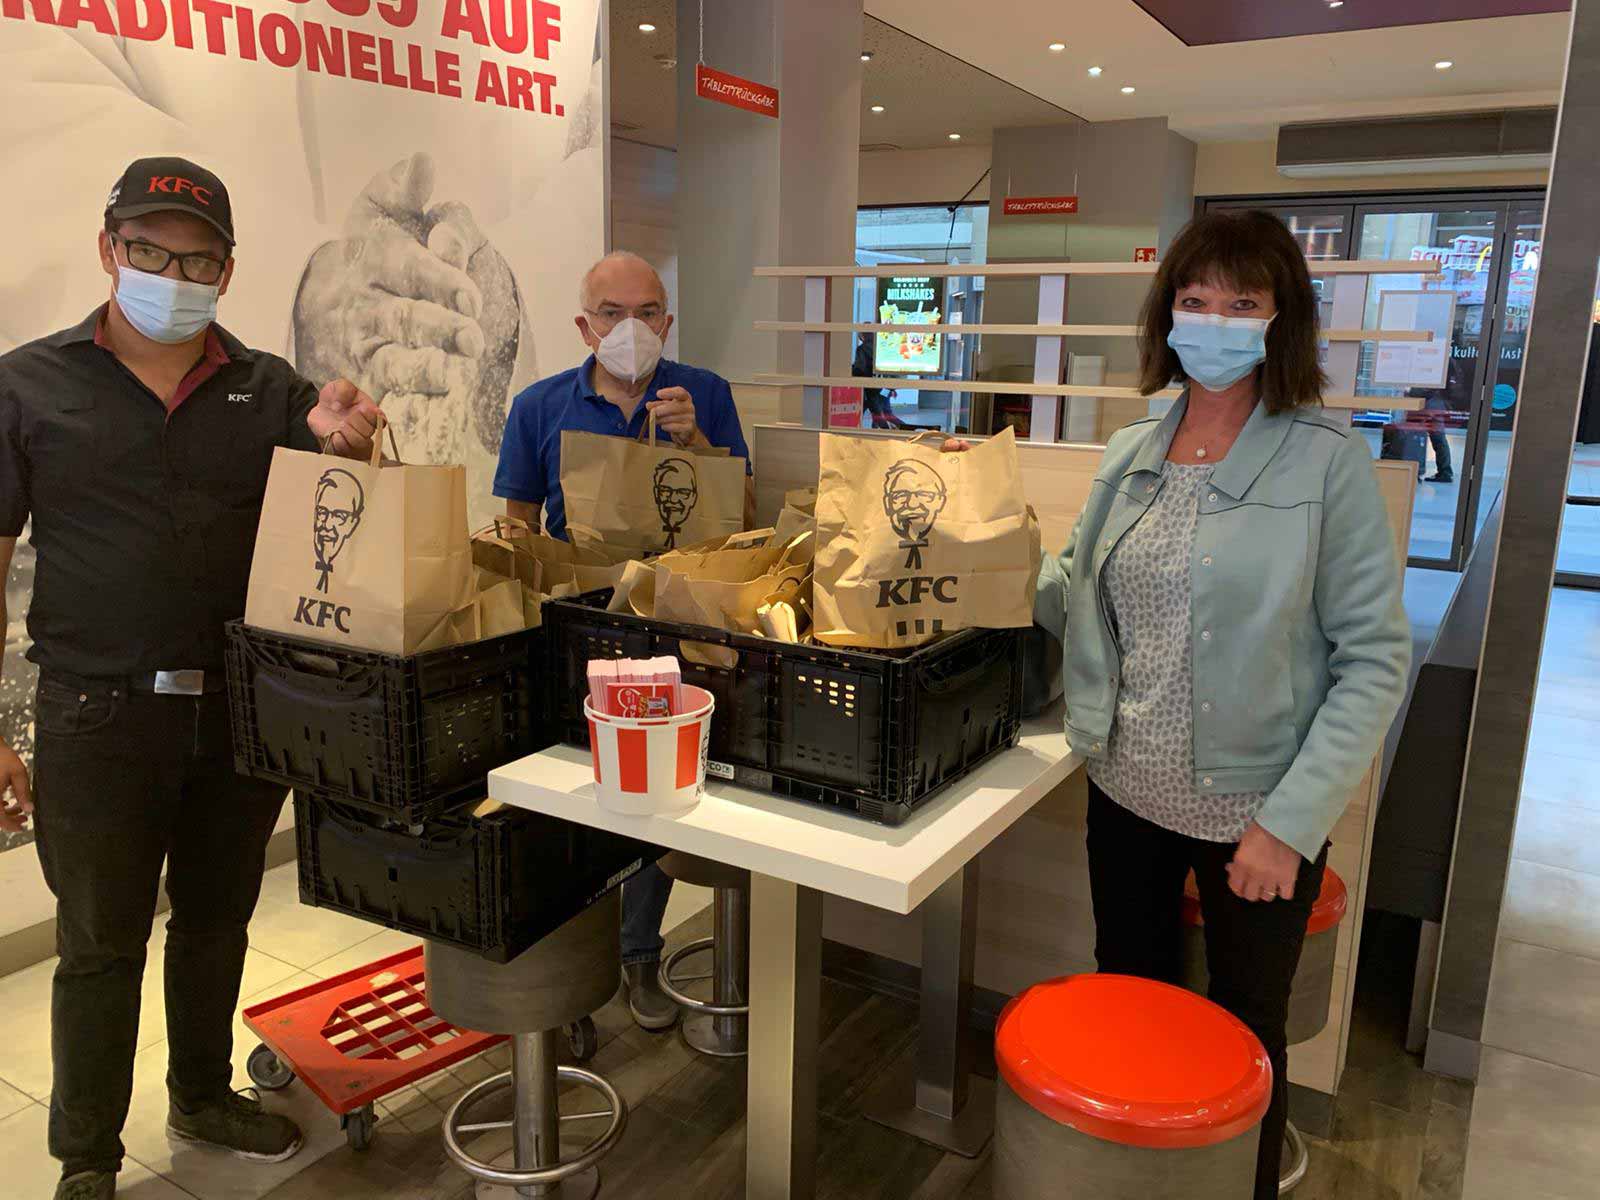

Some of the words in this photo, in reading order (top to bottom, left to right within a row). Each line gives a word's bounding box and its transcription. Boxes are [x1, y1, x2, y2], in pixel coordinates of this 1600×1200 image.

[440, 0, 560, 61] AUF
[475, 60, 565, 117] ART.
[701, 77, 775, 108] TABLETTRÜCKGABE
[145, 176, 213, 206] KFC
[886, 288, 936, 300] MILKSHAKES
[227, 393, 253, 402] KFC
[875, 575, 959, 608] KFC
[293, 596, 352, 634] KFC
